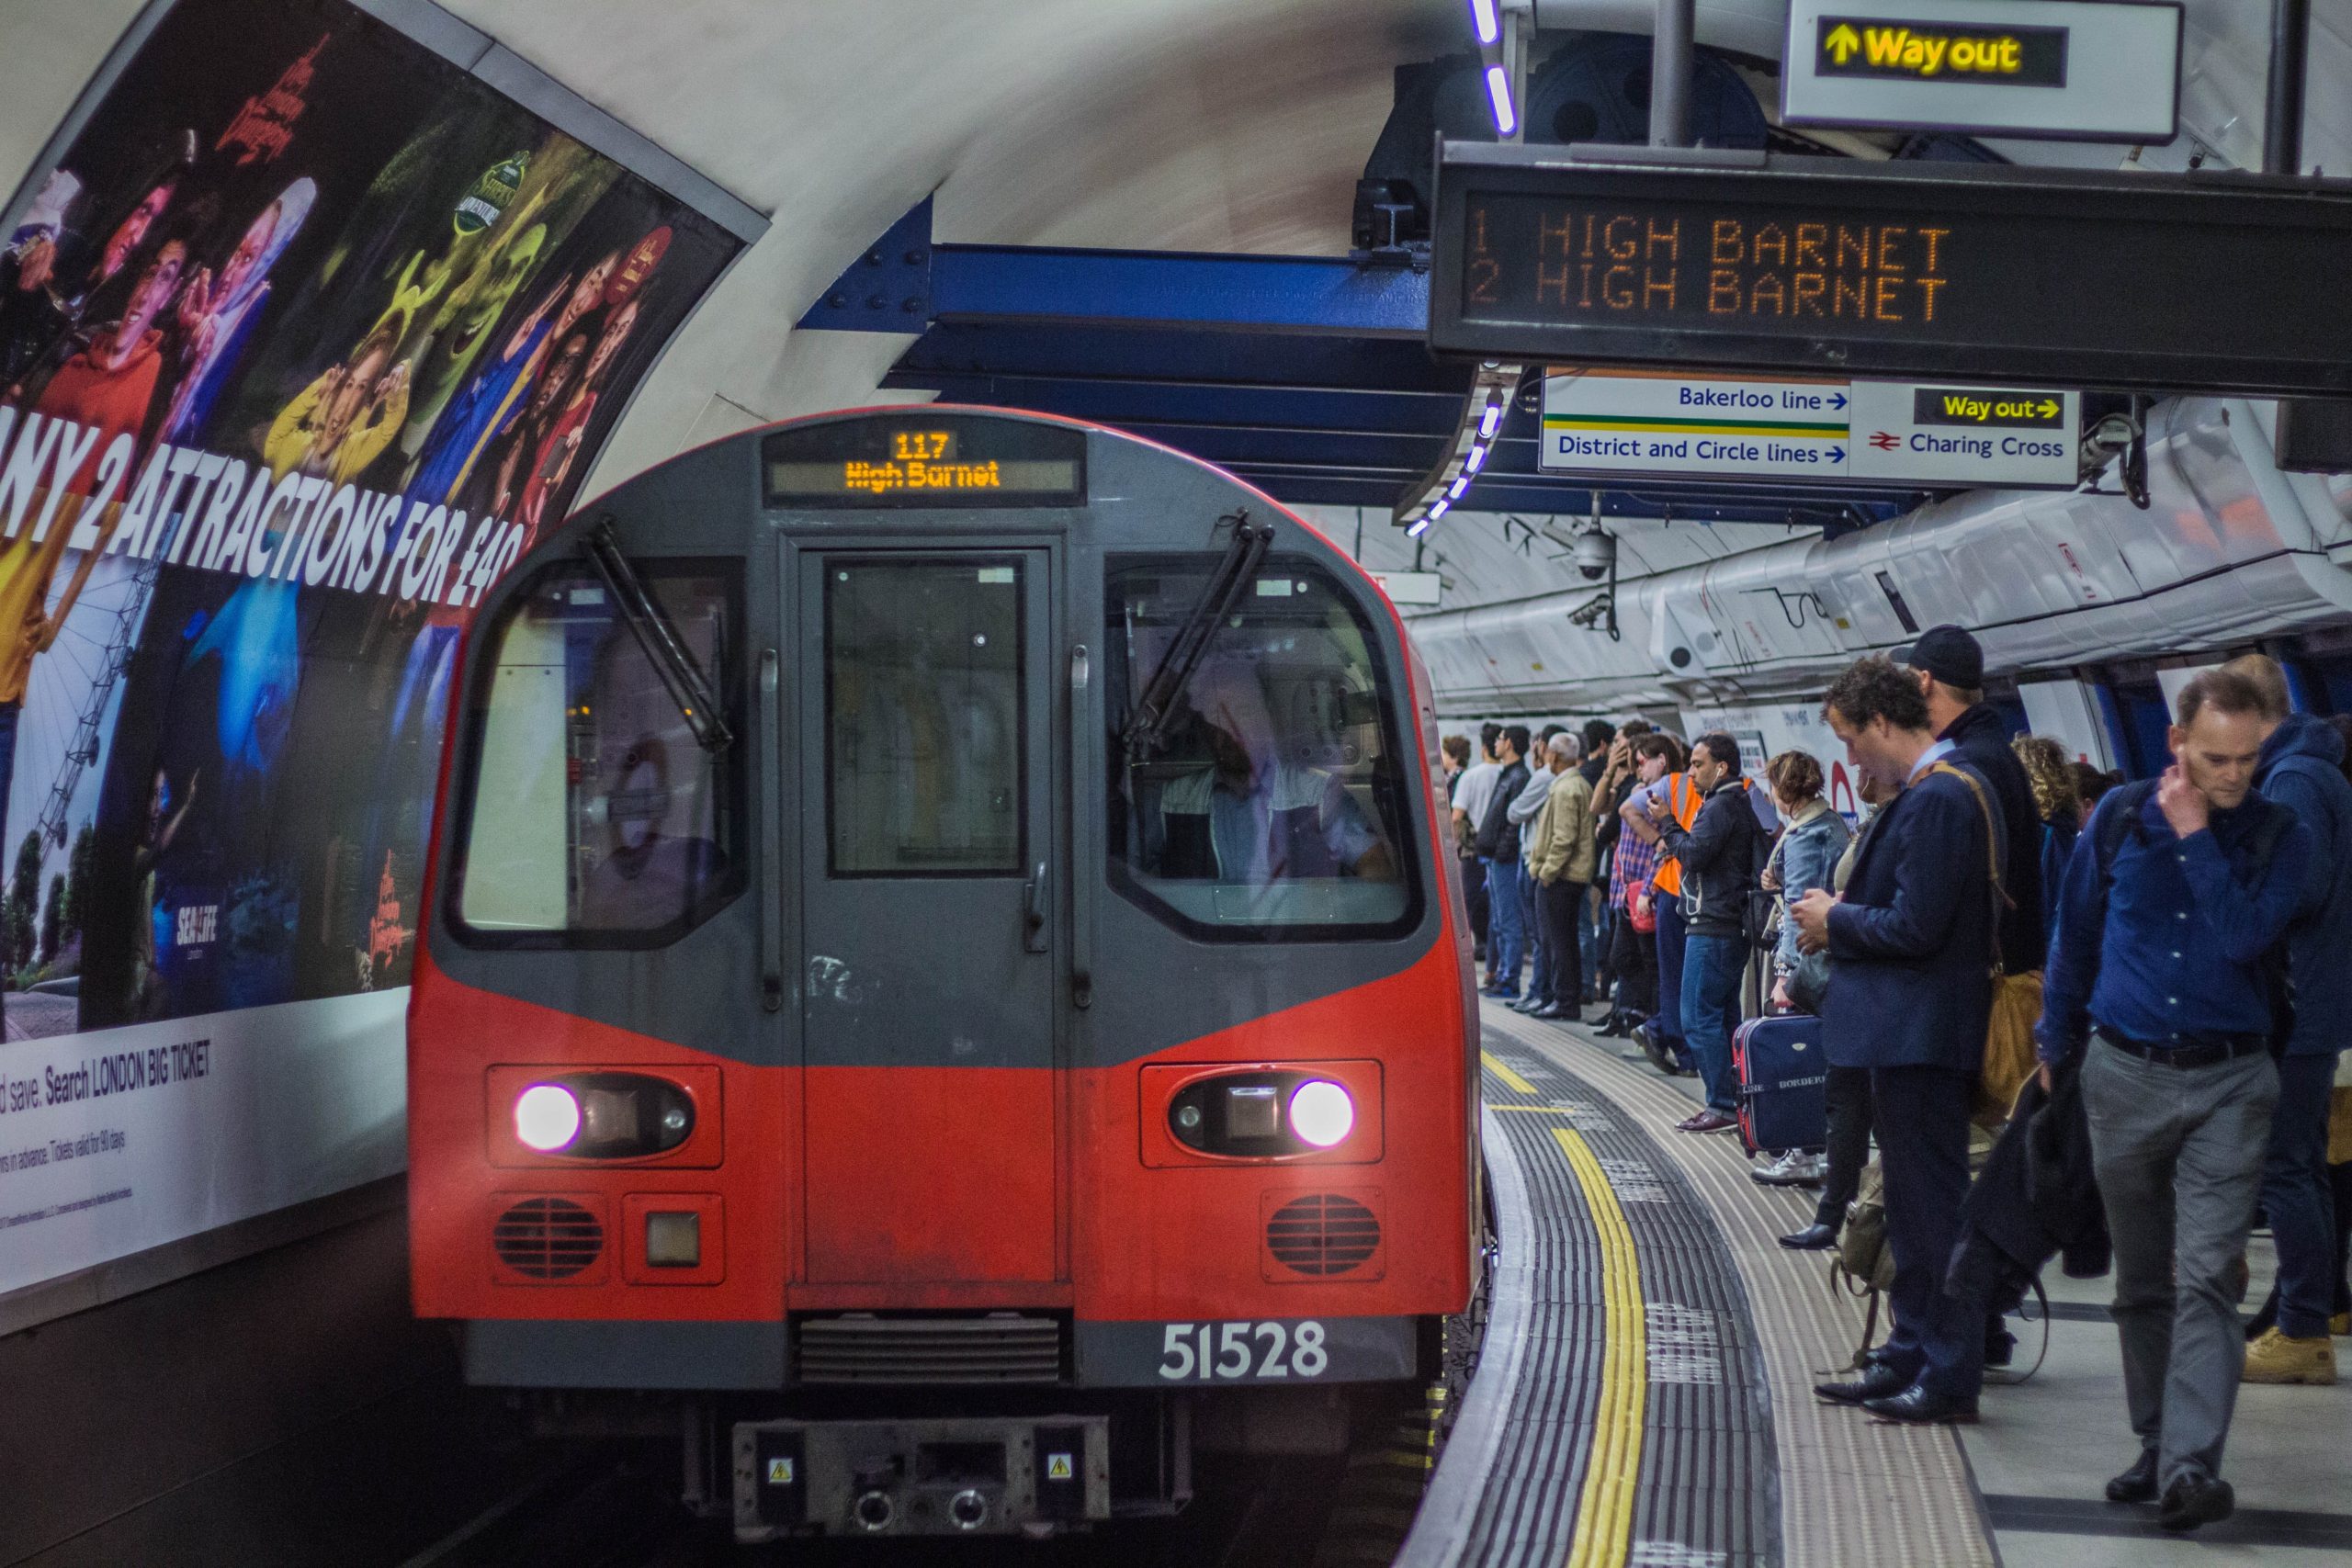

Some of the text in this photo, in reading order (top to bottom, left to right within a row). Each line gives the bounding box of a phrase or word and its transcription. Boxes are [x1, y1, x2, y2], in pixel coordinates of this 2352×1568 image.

[1864, 28, 2020, 74] Way out
[1474, 209, 1951, 272] 1 HIGH BARNET
[1470, 258, 1499, 302] 2
[1536, 261, 1677, 310] HIGH
[1708, 268, 1947, 321] BARNET
[1679, 387, 1822, 410] Bakerloo line
[1943, 395, 2034, 421] Way out
[896, 432, 949, 459] 117
[1558, 435, 1819, 463] District and Circle lines
[1909, 433, 2064, 458] Charing Cross
[846, 460, 1001, 494] High Barnet
[68, 433, 134, 551] 2
[106, 442, 402, 593] ATTRACTIONS
[379, 501, 467, 603] FOR
[447, 515, 525, 608] £40
[10, 1077, 42, 1113] save.
[46, 1063, 89, 1106] Search
[93, 1051, 145, 1098] LONDON
[149, 1046, 169, 1088] BIG
[171, 1039, 210, 1083] TICKET
[1159, 1320, 1329, 1380] 51528
